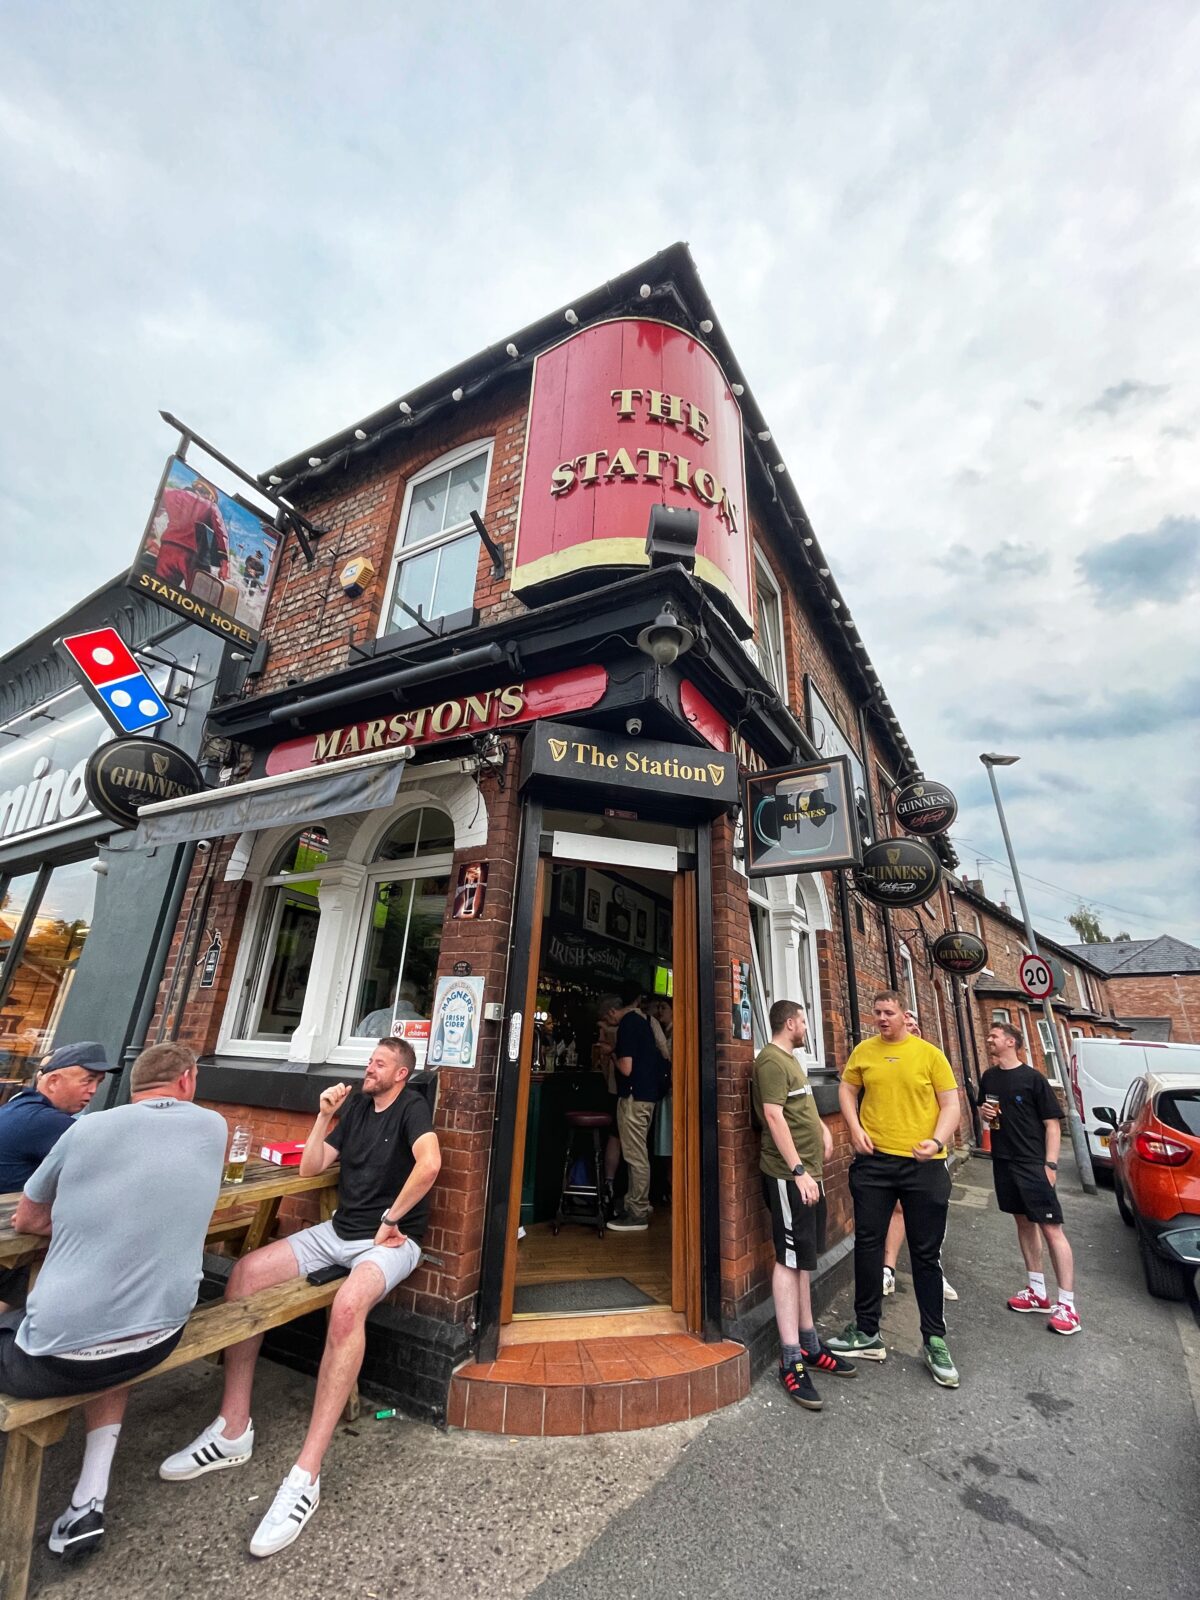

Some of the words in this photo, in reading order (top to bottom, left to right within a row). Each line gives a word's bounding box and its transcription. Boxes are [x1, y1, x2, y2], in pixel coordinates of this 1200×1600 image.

[610, 388, 711, 443] THE
[550, 447, 739, 535] STATION
[140, 574, 206, 619] STATION
[210, 612, 254, 645] HOTEL
[311, 683, 525, 761] MARSTON'S
[571, 742, 619, 769] The
[625, 751, 707, 783] Station
[110, 766, 193, 799] GUINNESS
[783, 807, 827, 823] GUINNESS
[896, 794, 951, 815] GUINNESS
[865, 865, 928, 881] GUINNESS
[940, 949, 981, 960] GUINNESS
[1024, 966, 1049, 987] 20
[441, 990, 476, 1014] MAGNER'S
[407, 1030, 429, 1038] children
[444, 1020, 466, 1029] CIDER
